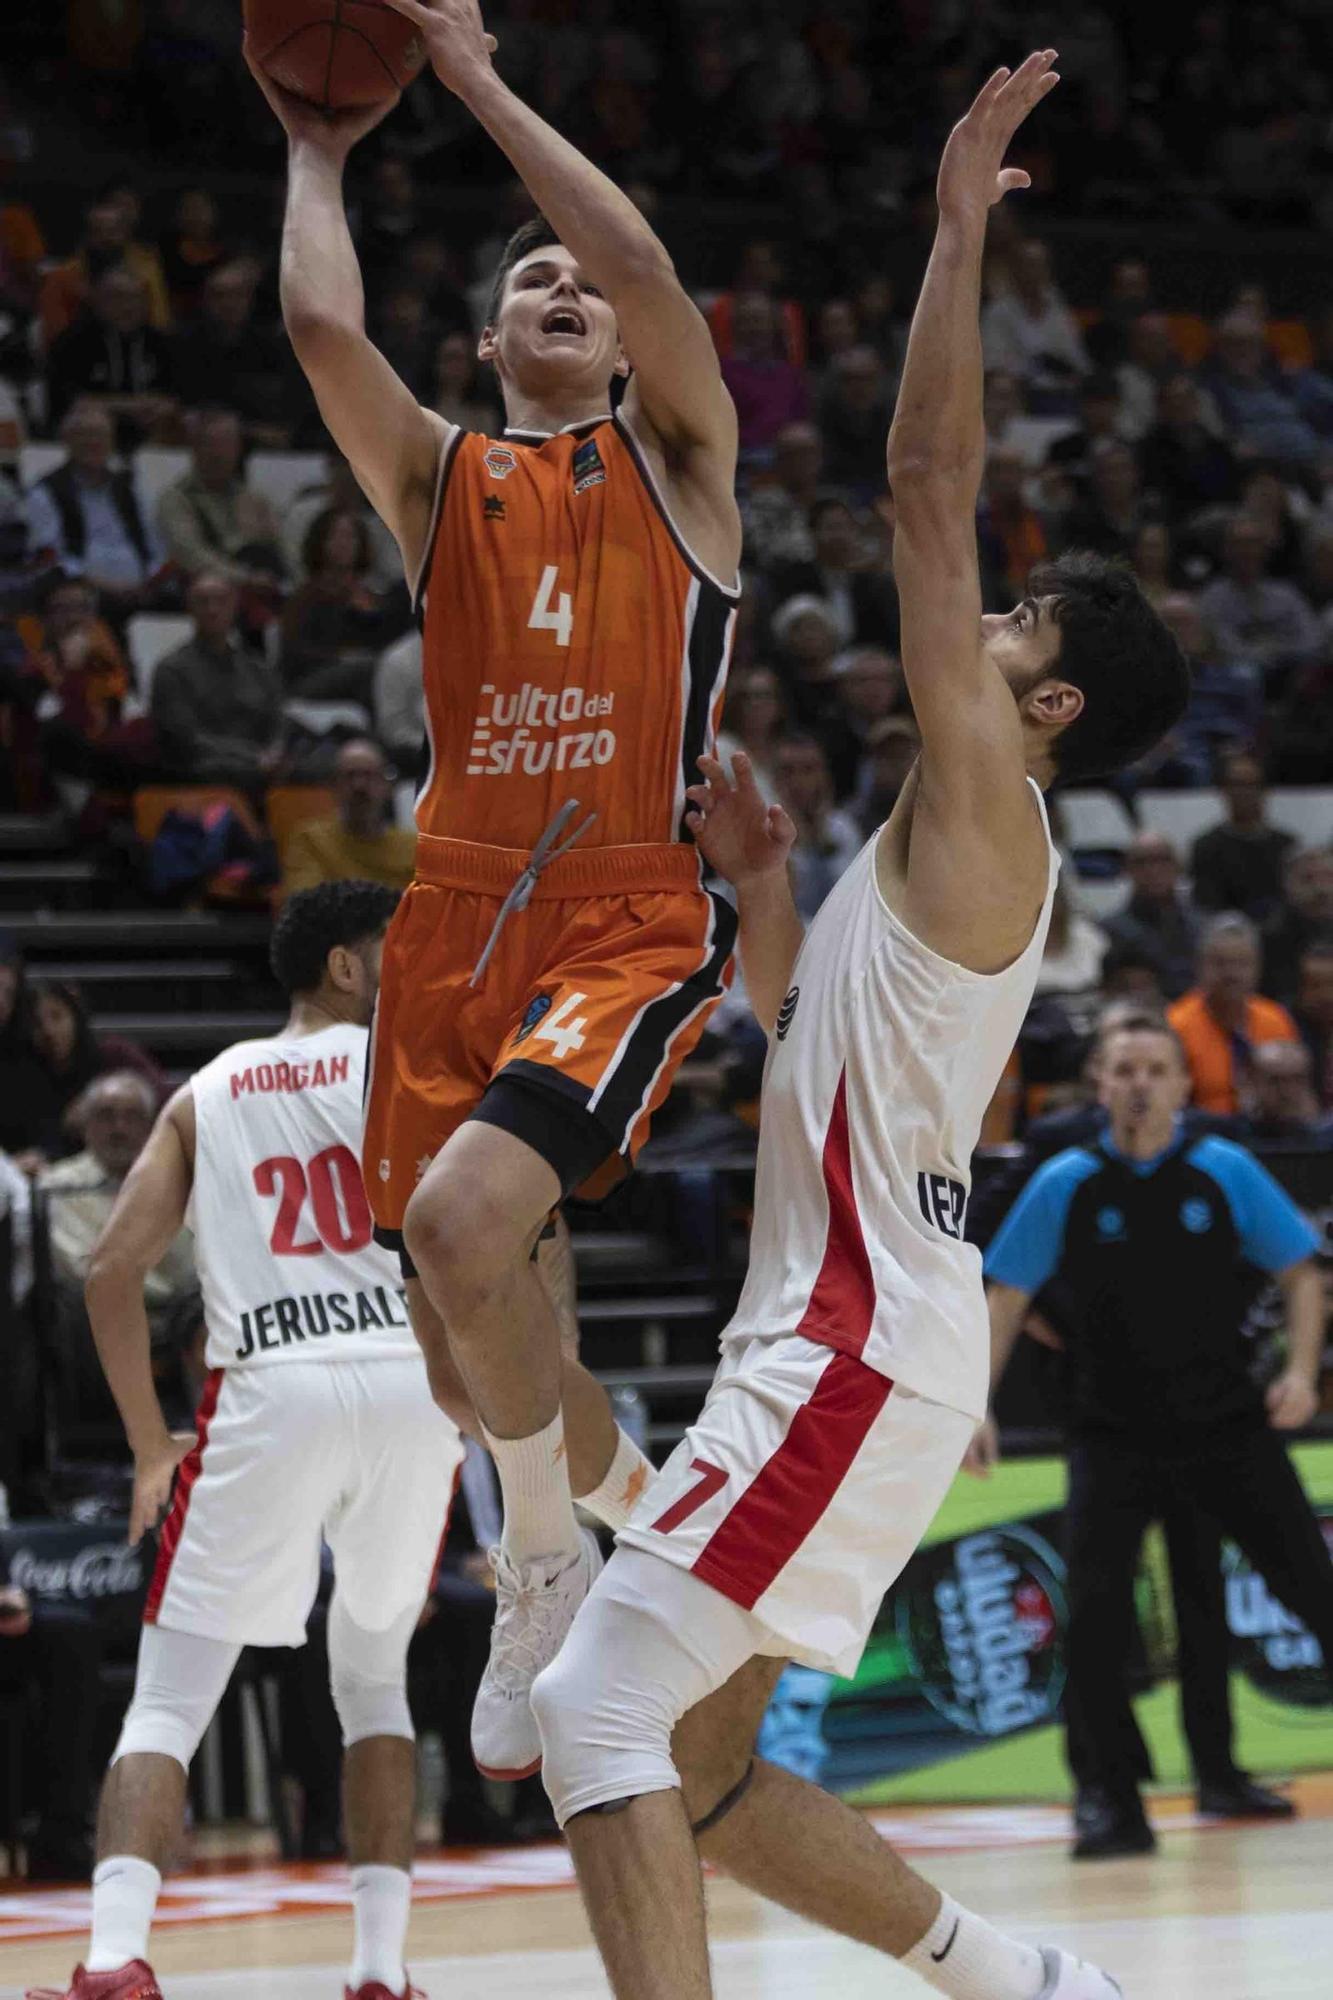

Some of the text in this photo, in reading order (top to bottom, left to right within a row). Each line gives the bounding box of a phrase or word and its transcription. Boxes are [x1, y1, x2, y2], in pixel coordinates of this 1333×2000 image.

[527, 565, 573, 647] 4
[583, 691, 615, 718] del
[533, 992, 588, 1058] 4
[230, 1055, 349, 1101] MORGAN
[253, 1144, 374, 1257] 20
[649, 1457, 730, 1535] 7
